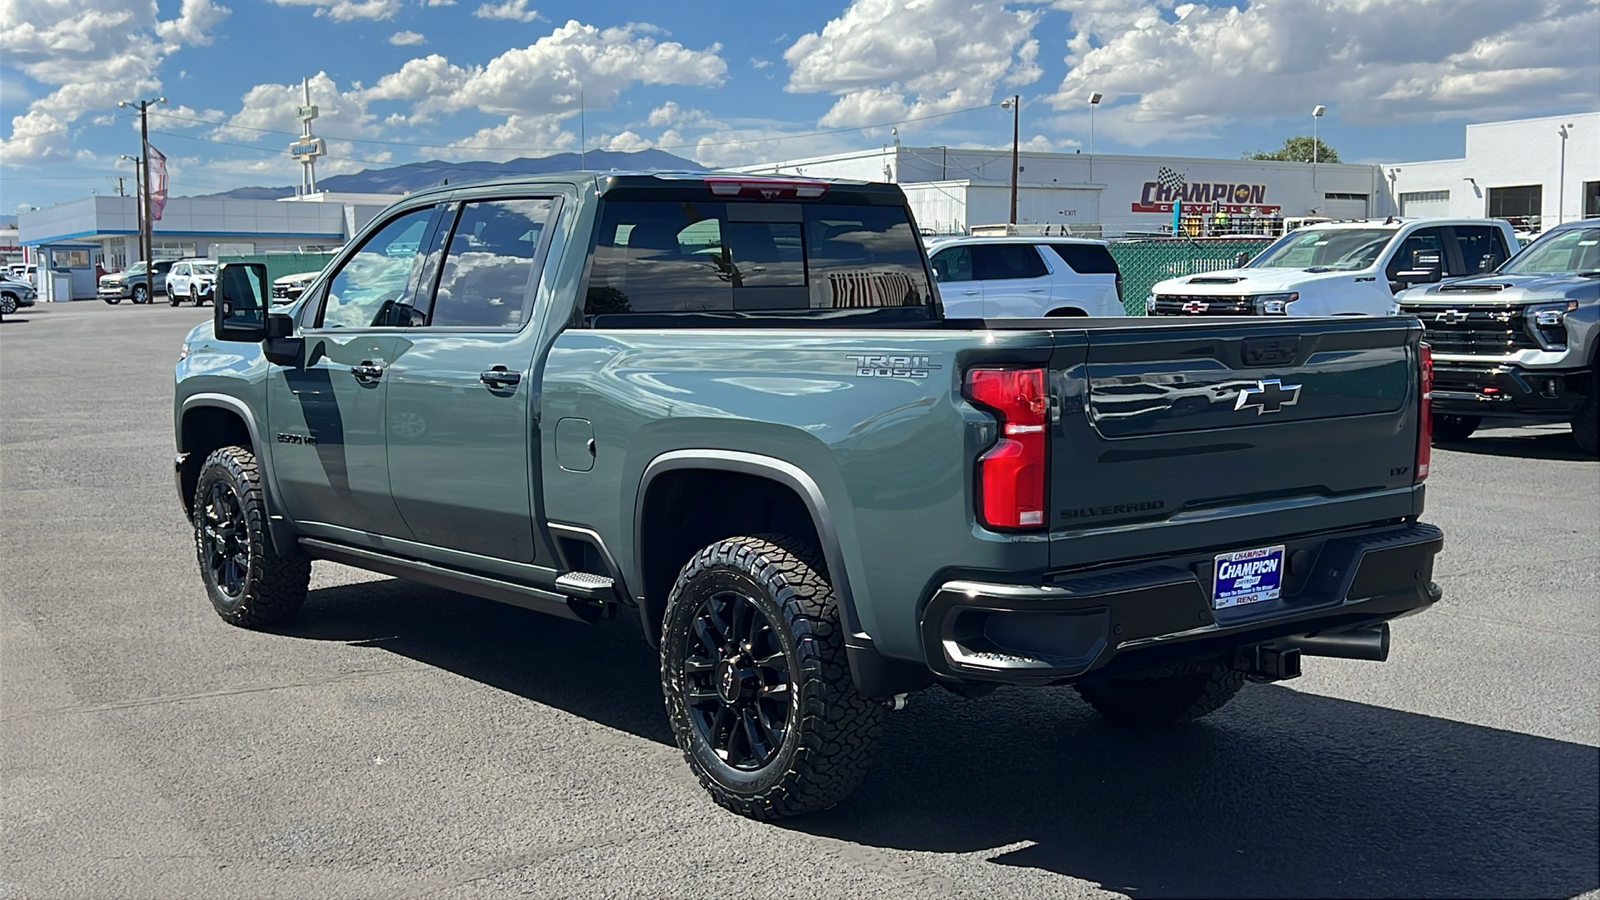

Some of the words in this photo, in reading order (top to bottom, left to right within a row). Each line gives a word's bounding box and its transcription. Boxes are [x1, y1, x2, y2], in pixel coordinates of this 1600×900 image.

[1140, 182, 1266, 207] CHAMPION
[845, 354, 943, 370] TRAIL
[856, 367, 929, 379] BOSS
[1060, 500, 1165, 519] SILVERADO
[1234, 549, 1268, 560] CHAMPION
[1218, 559, 1279, 580] CHAMPION
[1235, 577, 1259, 586] CHEVROLET
[1236, 594, 1259, 604] RENO
